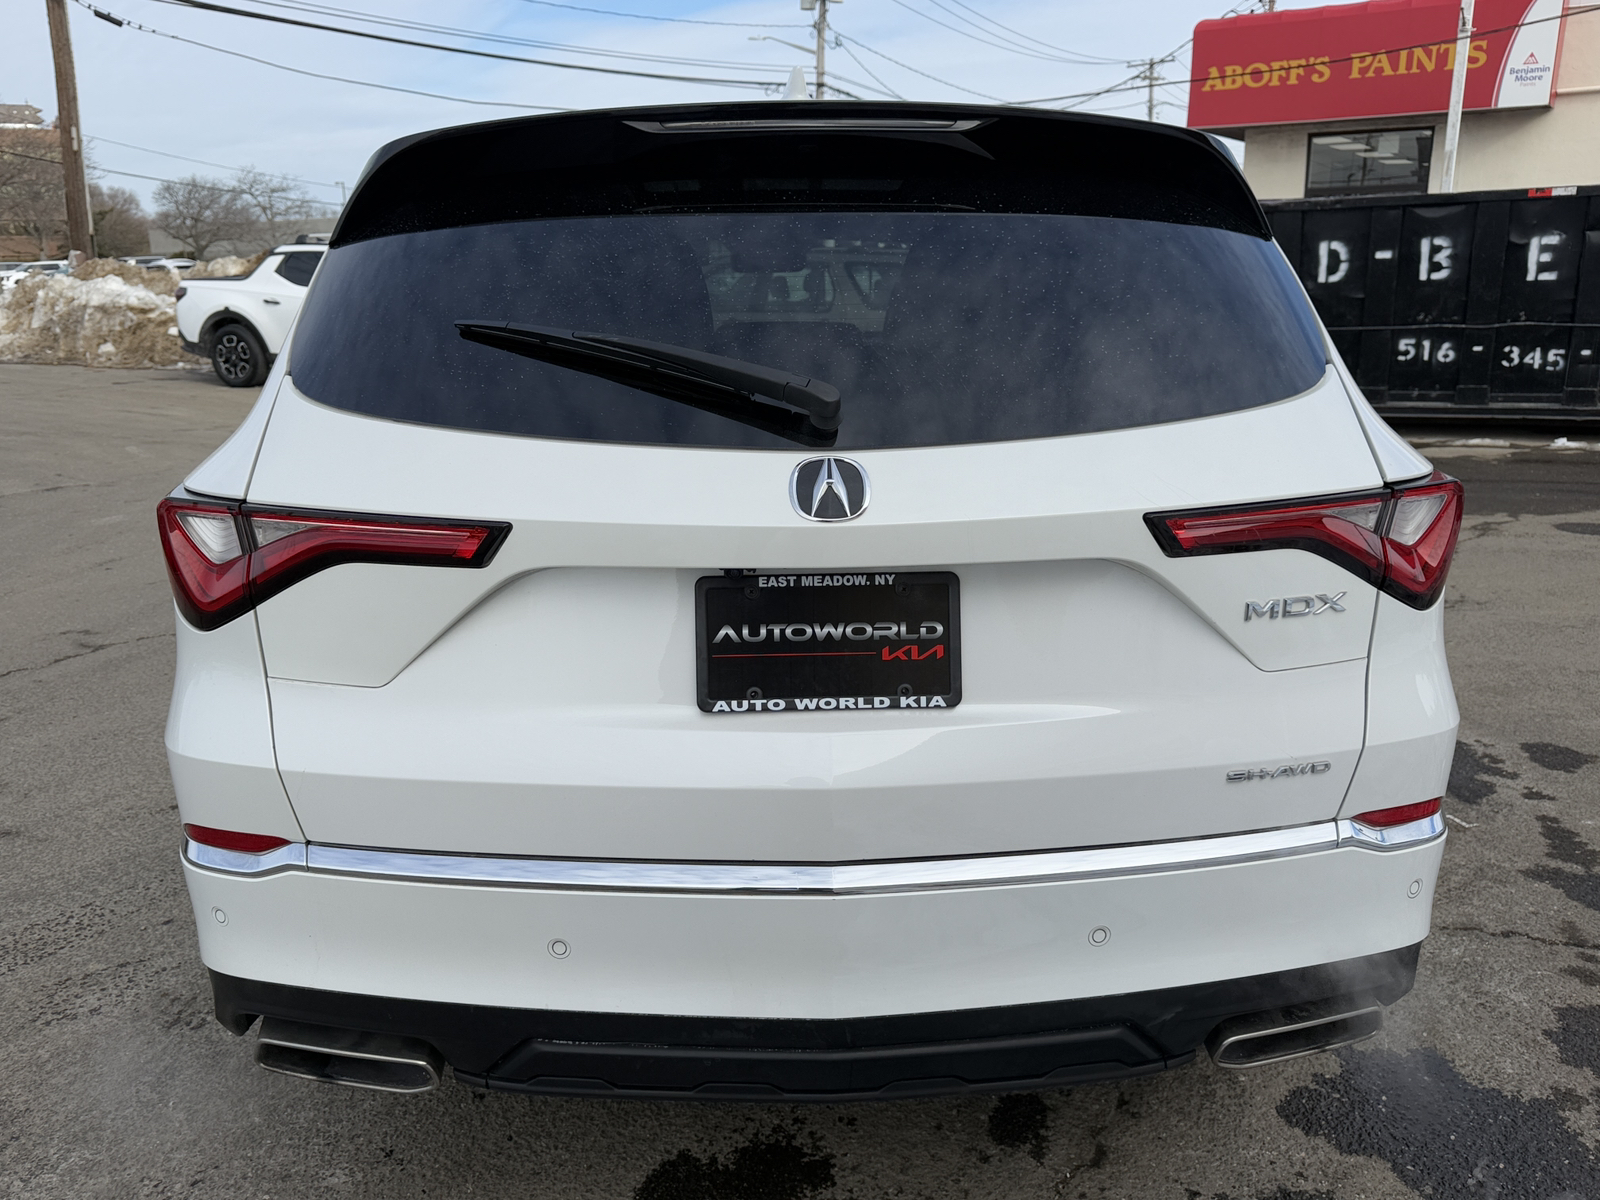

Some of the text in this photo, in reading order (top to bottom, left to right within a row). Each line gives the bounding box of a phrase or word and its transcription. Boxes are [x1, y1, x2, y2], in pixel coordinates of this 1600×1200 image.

[1202, 40, 1488, 91] ABOFF'S PAINTS
[1510, 65, 1551, 75] Benjamin
[758, 576, 796, 587] EAST
[875, 574, 895, 585] NY
[1244, 591, 1347, 622] MDX
[712, 621, 944, 643] AUTOWORLD
[712, 695, 947, 712] AUTO WORLD KIA
[1226, 760, 1331, 783] SH-AWD
